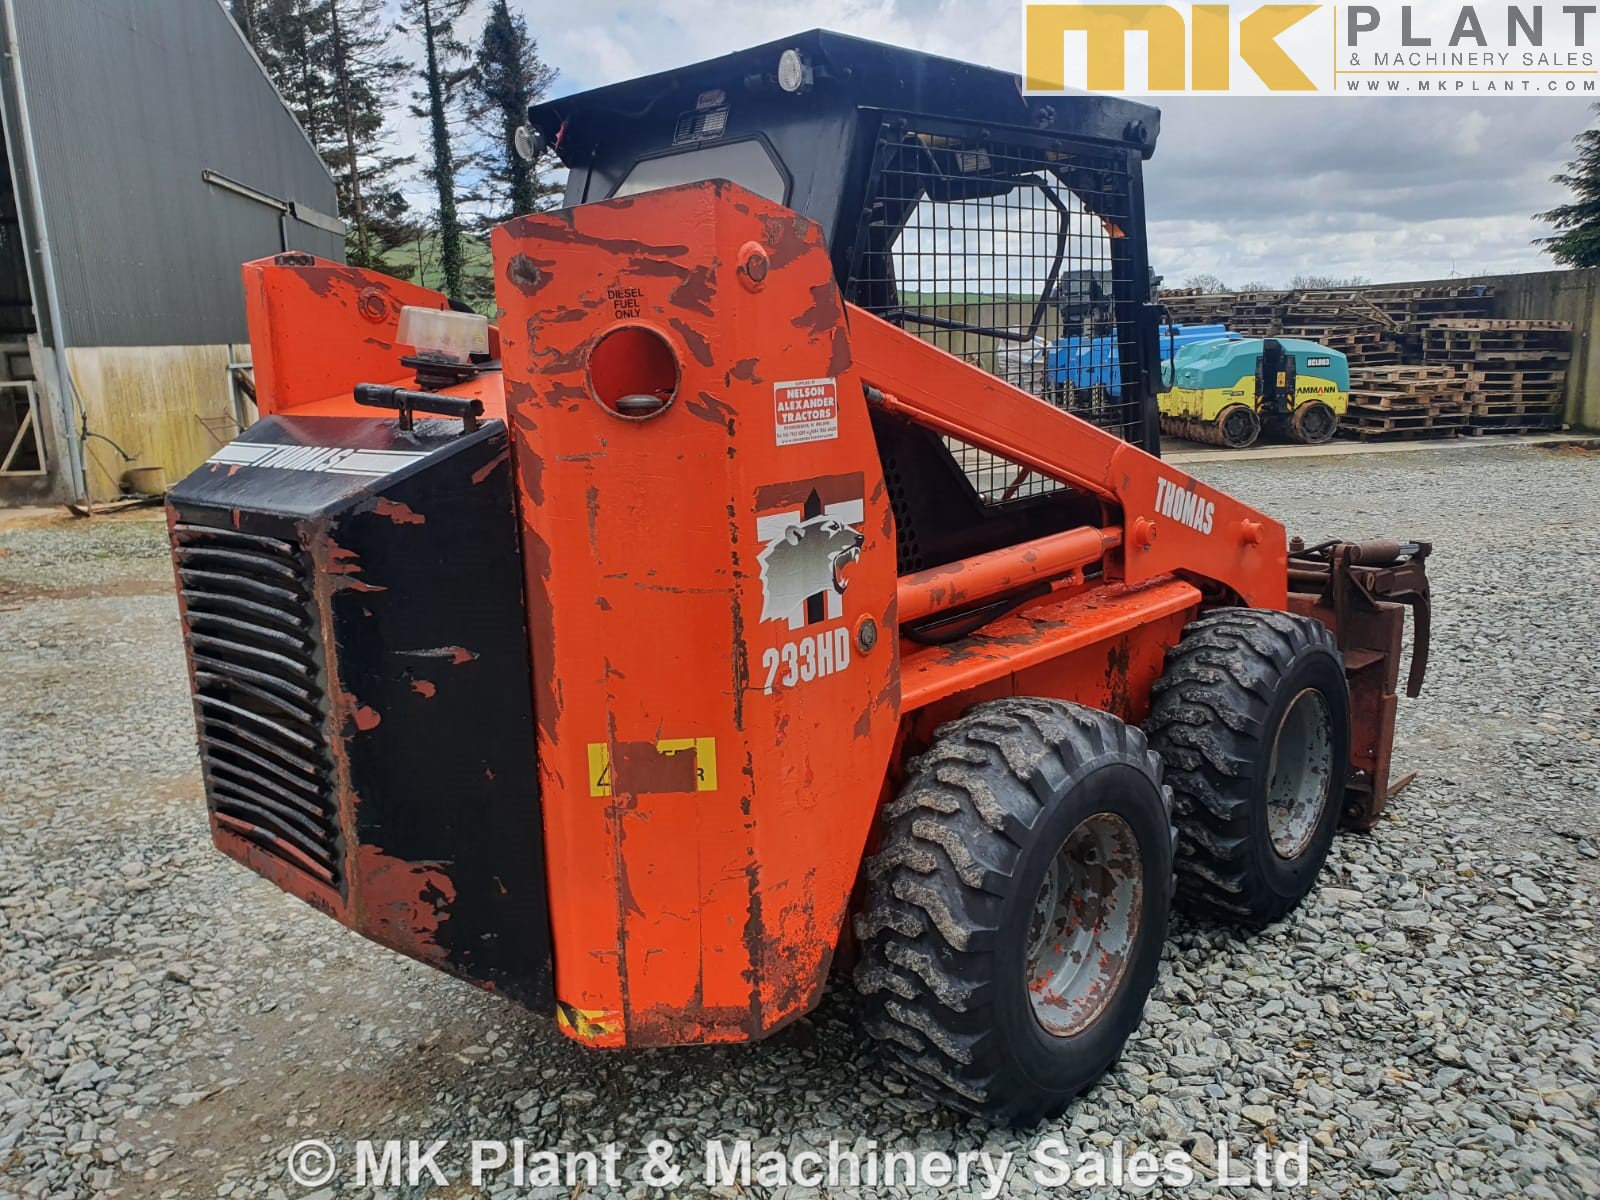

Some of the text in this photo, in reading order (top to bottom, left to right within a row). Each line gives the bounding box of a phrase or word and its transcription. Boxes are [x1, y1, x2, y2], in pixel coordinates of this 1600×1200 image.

[607, 288, 645, 300] DIESEL
[613, 298, 641, 309] FUEL
[614, 308, 641, 320] ONLY
[786, 386, 825, 399] NELSON
[1297, 386, 1336, 394] AMMANN
[777, 397, 834, 412] ALEXANDER
[781, 409, 831, 423] TRACTORS
[251, 445, 355, 472] THOMAS
[1154, 476, 1215, 535] THOMAS
[762, 627, 850, 696] 233HD
